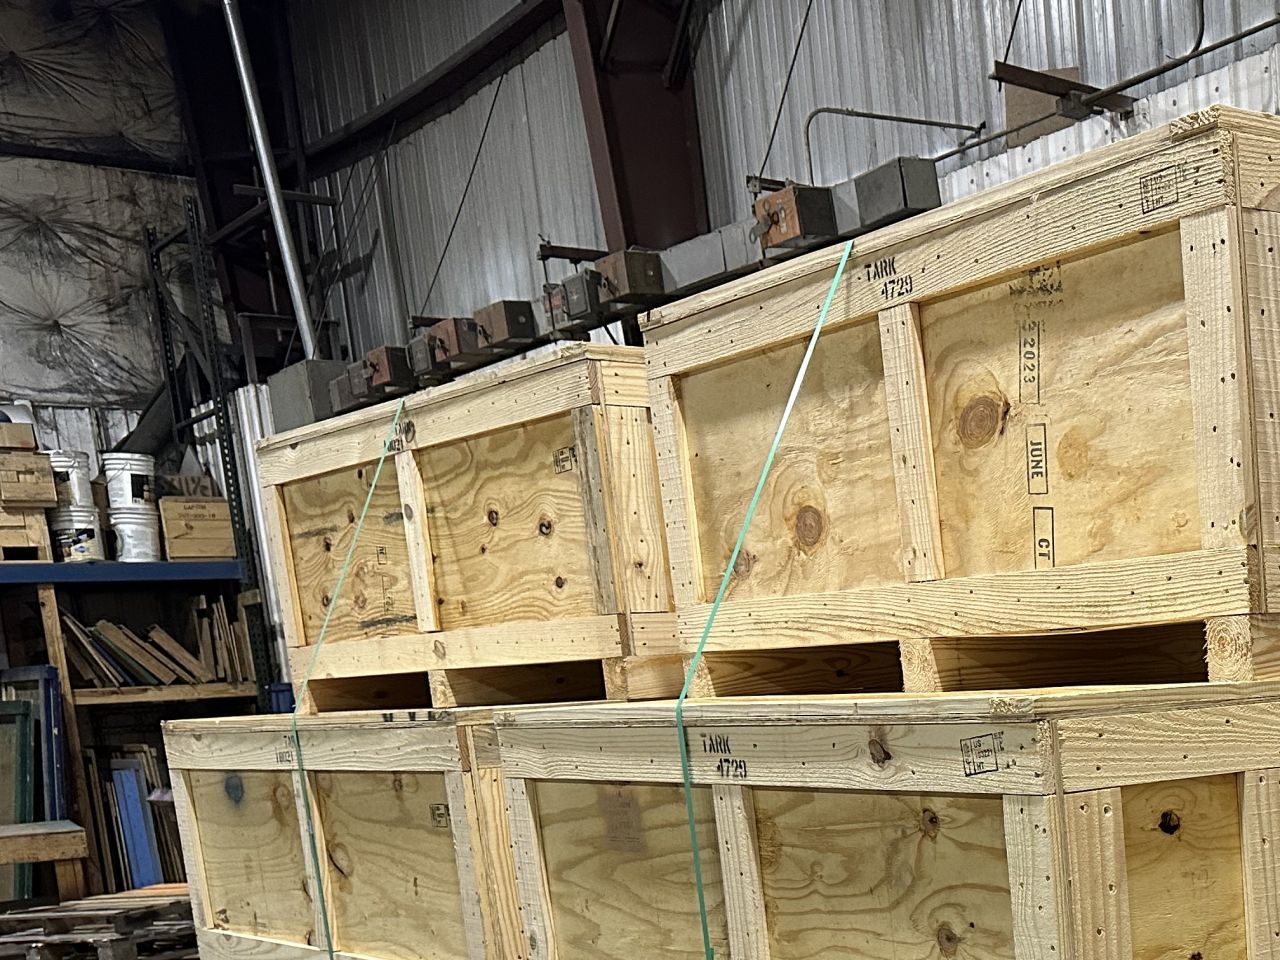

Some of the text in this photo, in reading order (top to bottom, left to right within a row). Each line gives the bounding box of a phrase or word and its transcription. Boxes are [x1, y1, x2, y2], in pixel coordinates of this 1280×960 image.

[864, 257, 897, 282] TARK
[881, 275, 913, 300] 4729
[1023, 338, 1036, 384] 2023
[1030, 441, 1043, 479] JUNE
[1038, 538, 1051, 560] CT
[700, 733, 731, 754] TARK
[717, 758, 747, 778] 4729
